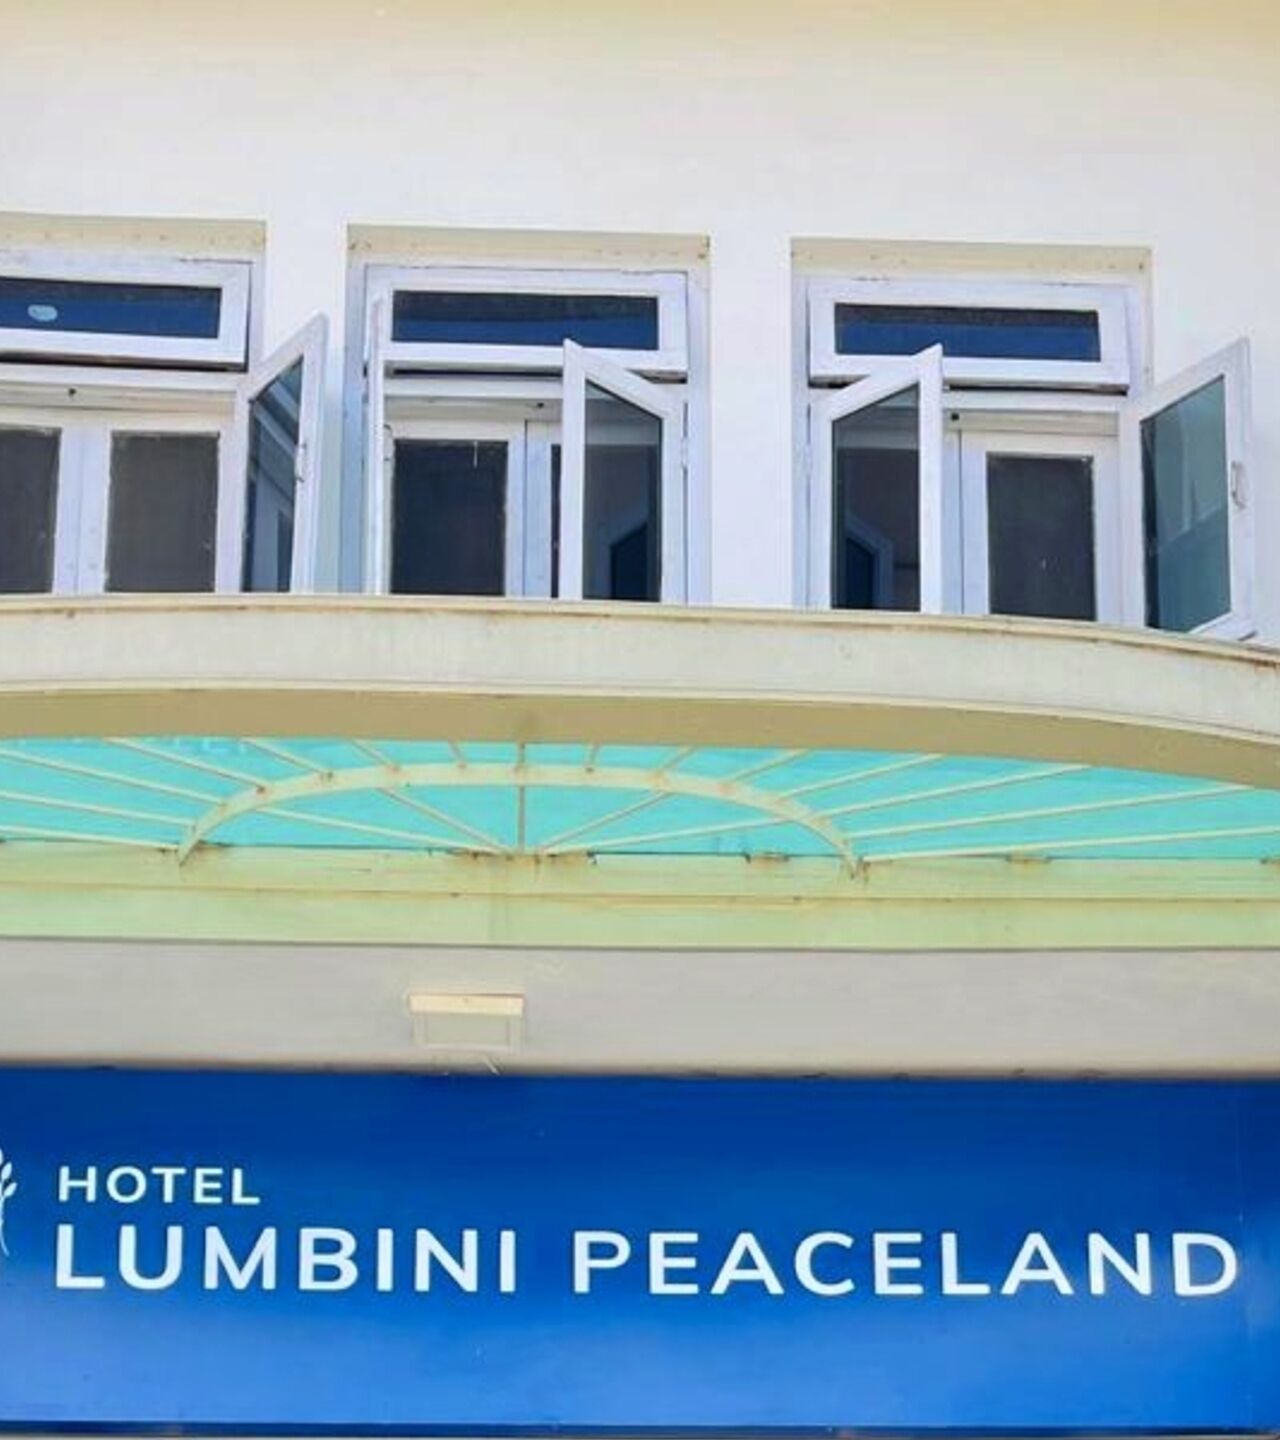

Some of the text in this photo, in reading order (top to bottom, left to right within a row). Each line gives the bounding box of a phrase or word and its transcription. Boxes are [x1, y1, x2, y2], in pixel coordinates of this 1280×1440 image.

[58, 1165, 261, 1205] HOTEL
[55, 1223, 1239, 1297] LUMBINI PEACELAND
